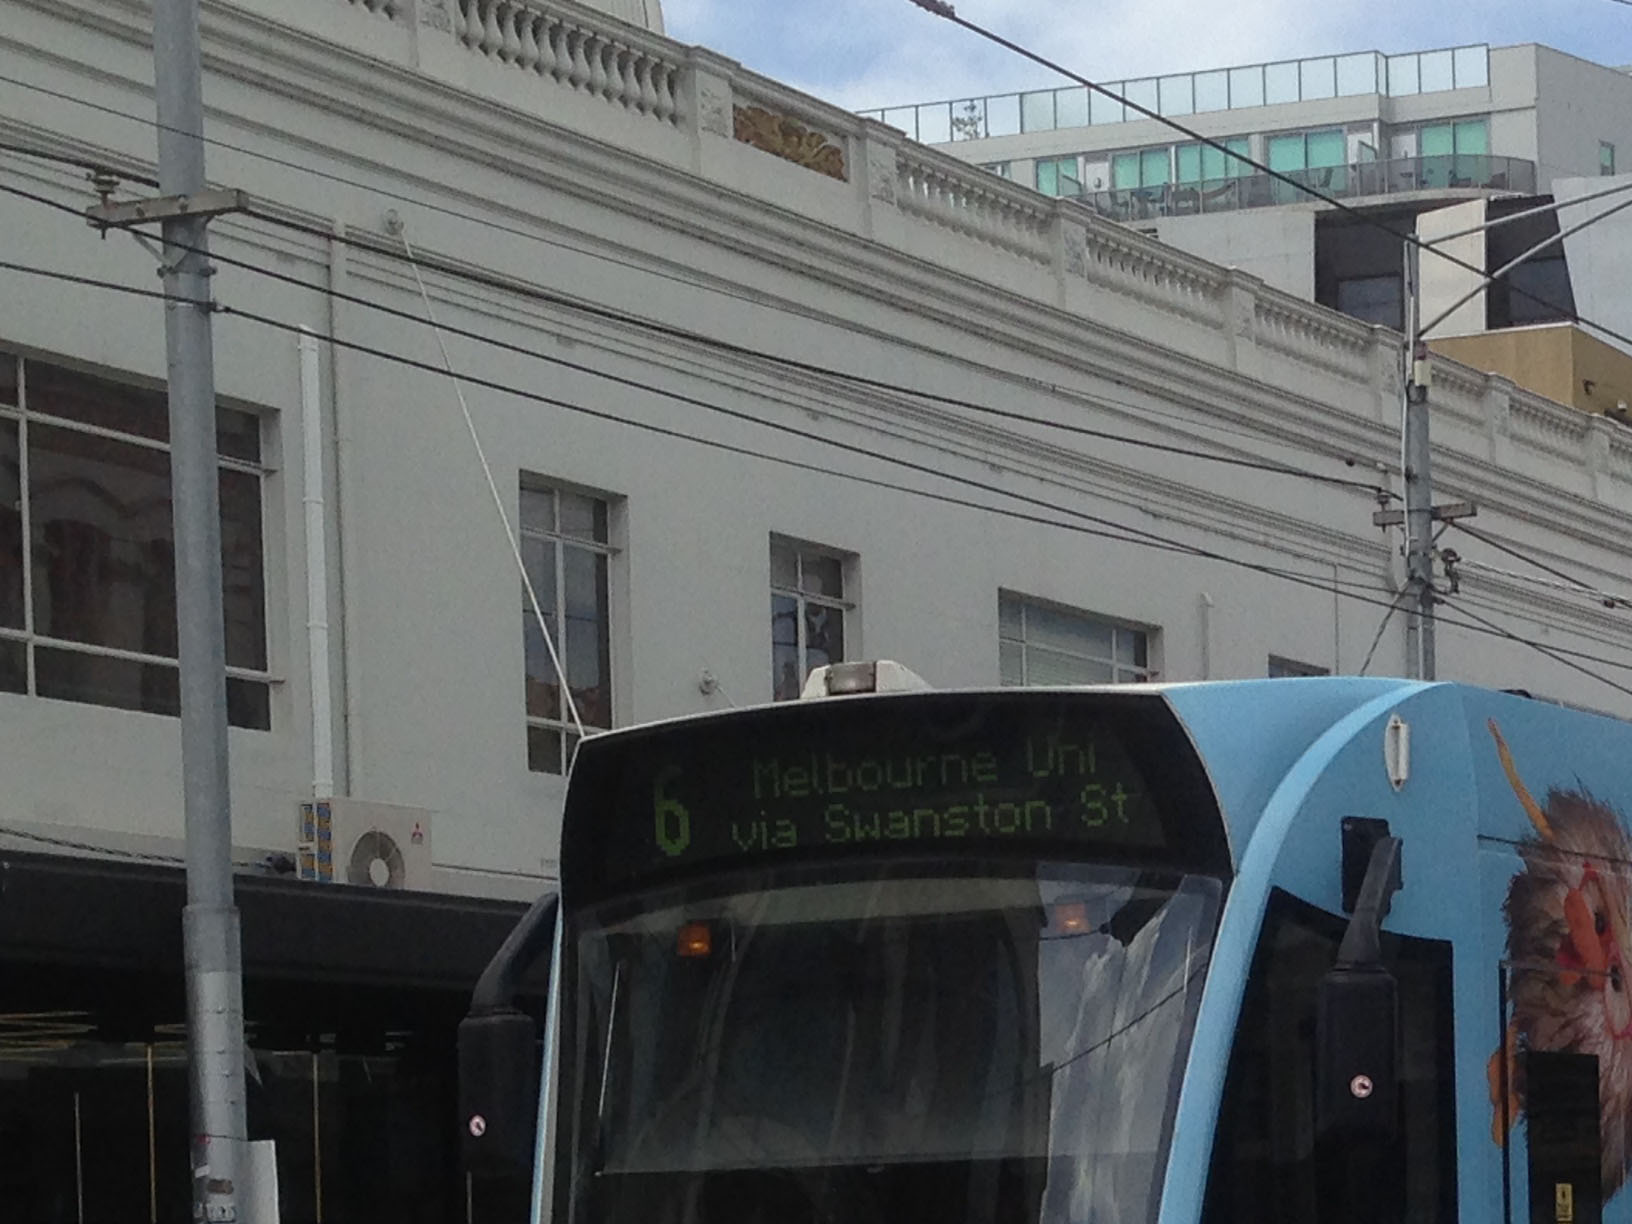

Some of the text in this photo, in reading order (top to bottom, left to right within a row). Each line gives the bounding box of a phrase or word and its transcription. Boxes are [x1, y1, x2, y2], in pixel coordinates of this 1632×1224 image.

[752, 732, 1097, 801] Melbourne Uni
[654, 764, 690, 857] 6
[730, 780, 1130, 853] via Swanston St
